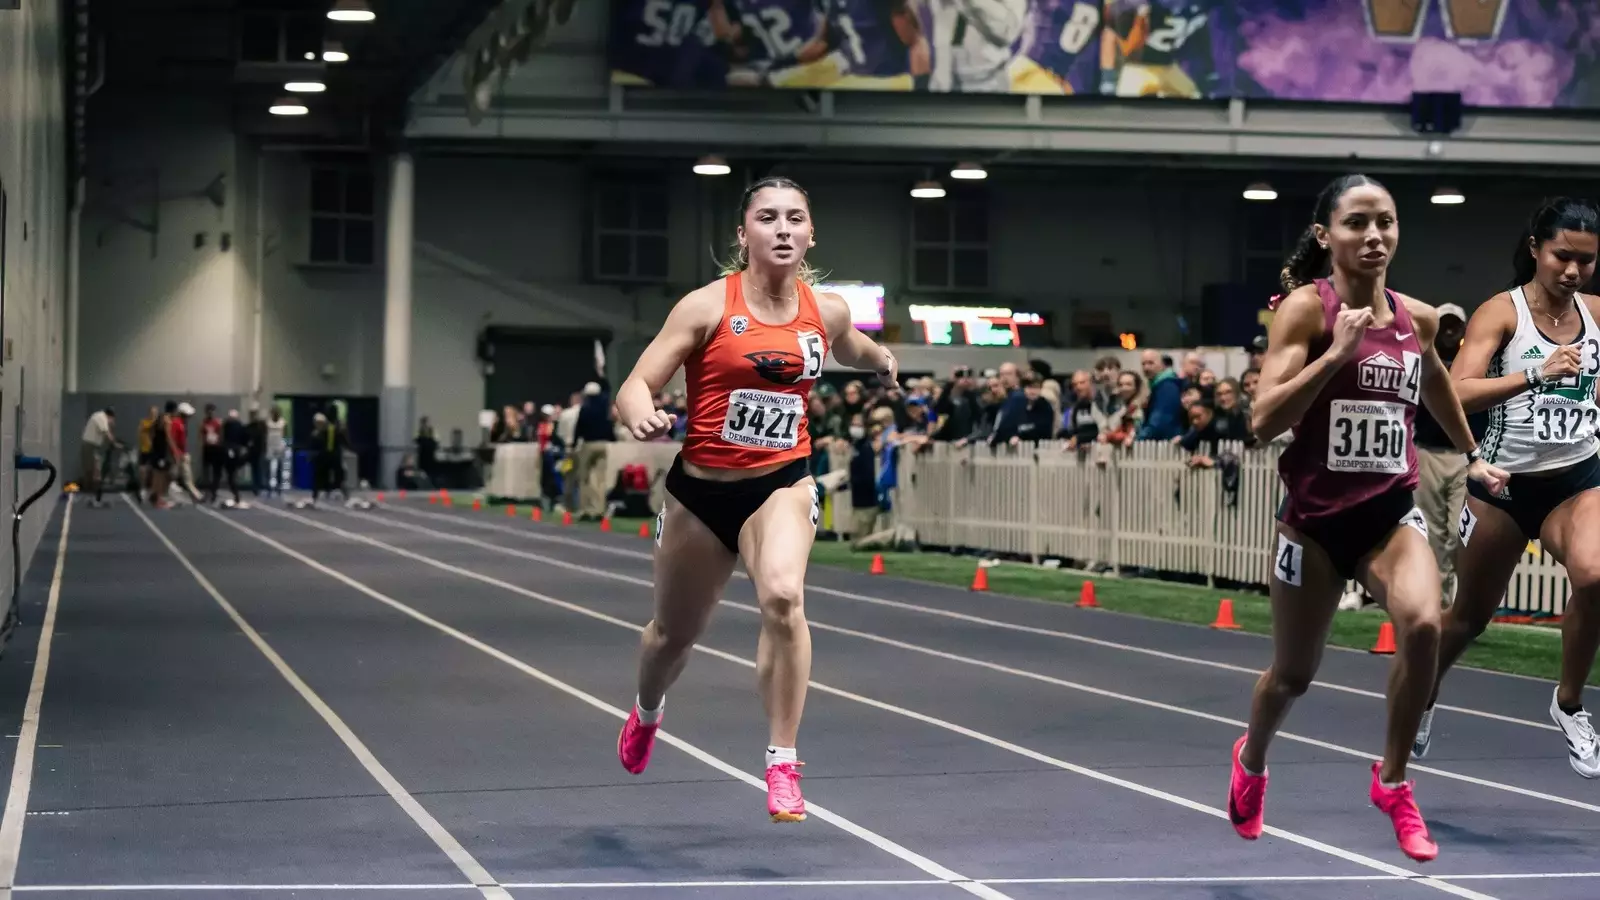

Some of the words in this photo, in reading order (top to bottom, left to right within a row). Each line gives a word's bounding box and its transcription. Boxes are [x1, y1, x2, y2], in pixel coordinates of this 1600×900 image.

[805, 337, 821, 377] 5
[1587, 338, 1600, 375] 3
[1361, 365, 1405, 390] CWU
[1406, 357, 1420, 400] 4
[739, 391, 797, 406] WASHINGTON
[728, 401, 797, 440] 3421
[1333, 417, 1404, 458] 3150
[728, 431, 765, 446] DEMPSEY
[765, 440, 793, 449] INDOOR
[1335, 459, 1374, 468] DEMPSEY
[1458, 507, 1471, 539] 3
[1278, 543, 1297, 582] 4
